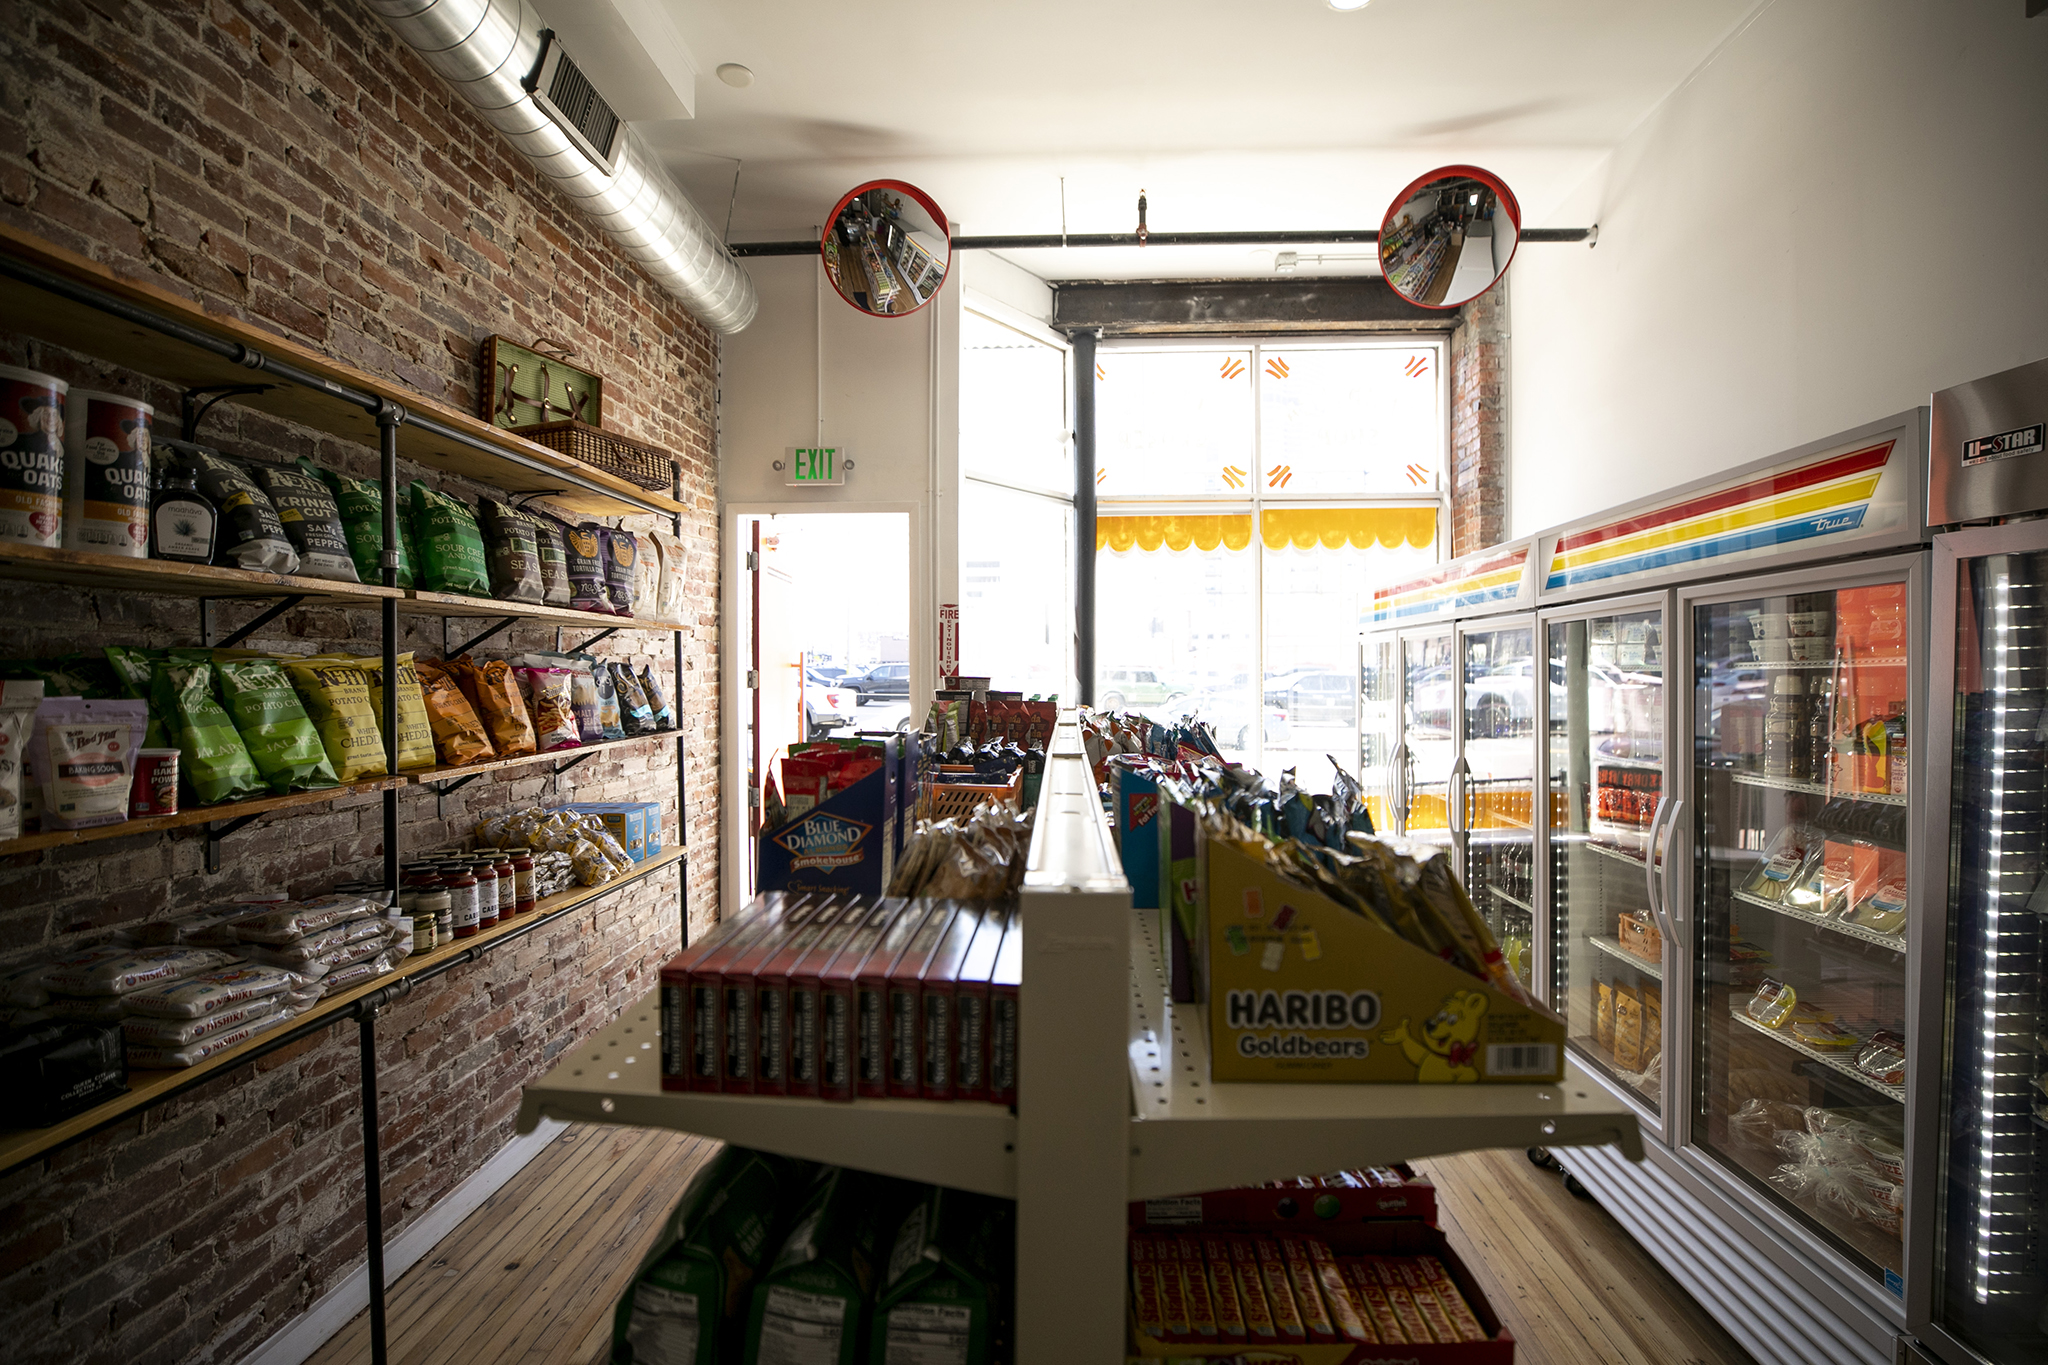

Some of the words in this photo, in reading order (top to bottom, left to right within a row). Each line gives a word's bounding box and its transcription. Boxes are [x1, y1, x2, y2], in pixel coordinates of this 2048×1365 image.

[1968, 429, 2036, 457] U-STAR
[1988, 453, 2002, 461] about
[2003, 450, 2016, 458] food
[2017, 447, 2034, 455] safety
[795, 448, 836, 480] EXIT
[23, 469, 63, 491] OATS
[303, 507, 332, 519] CUT
[431, 515, 466, 526] POTATO
[1810, 516, 1853, 532] true
[307, 523, 331, 533] SALT
[307, 537, 345, 550] PEPPER
[435, 543, 465, 553] SOUR
[510, 560, 531, 571] SEA
[541, 570, 559, 579] SEA
[940, 609, 959, 620] FIRE
[244, 701, 283, 714] POTATO
[328, 697, 363, 707] POTATO
[573, 709, 591, 718] MALT
[406, 722, 426, 730] WHITE
[76, 734, 97, 750] Red
[68, 765, 95, 775] BAKING
[96, 764, 117, 773] SODA
[804, 820, 841, 836] BLUE
[786, 826, 862, 850] DIAMOND
[139, 967, 176, 983] NISHIKI
[215, 990, 252, 1007] NISHIKI
[1230, 993, 1378, 1026] HARIBO
[207, 1011, 244, 1032] NISHIKI
[212, 1029, 249, 1052] NISHIKI
[1240, 1035, 1366, 1056] Goldbears
